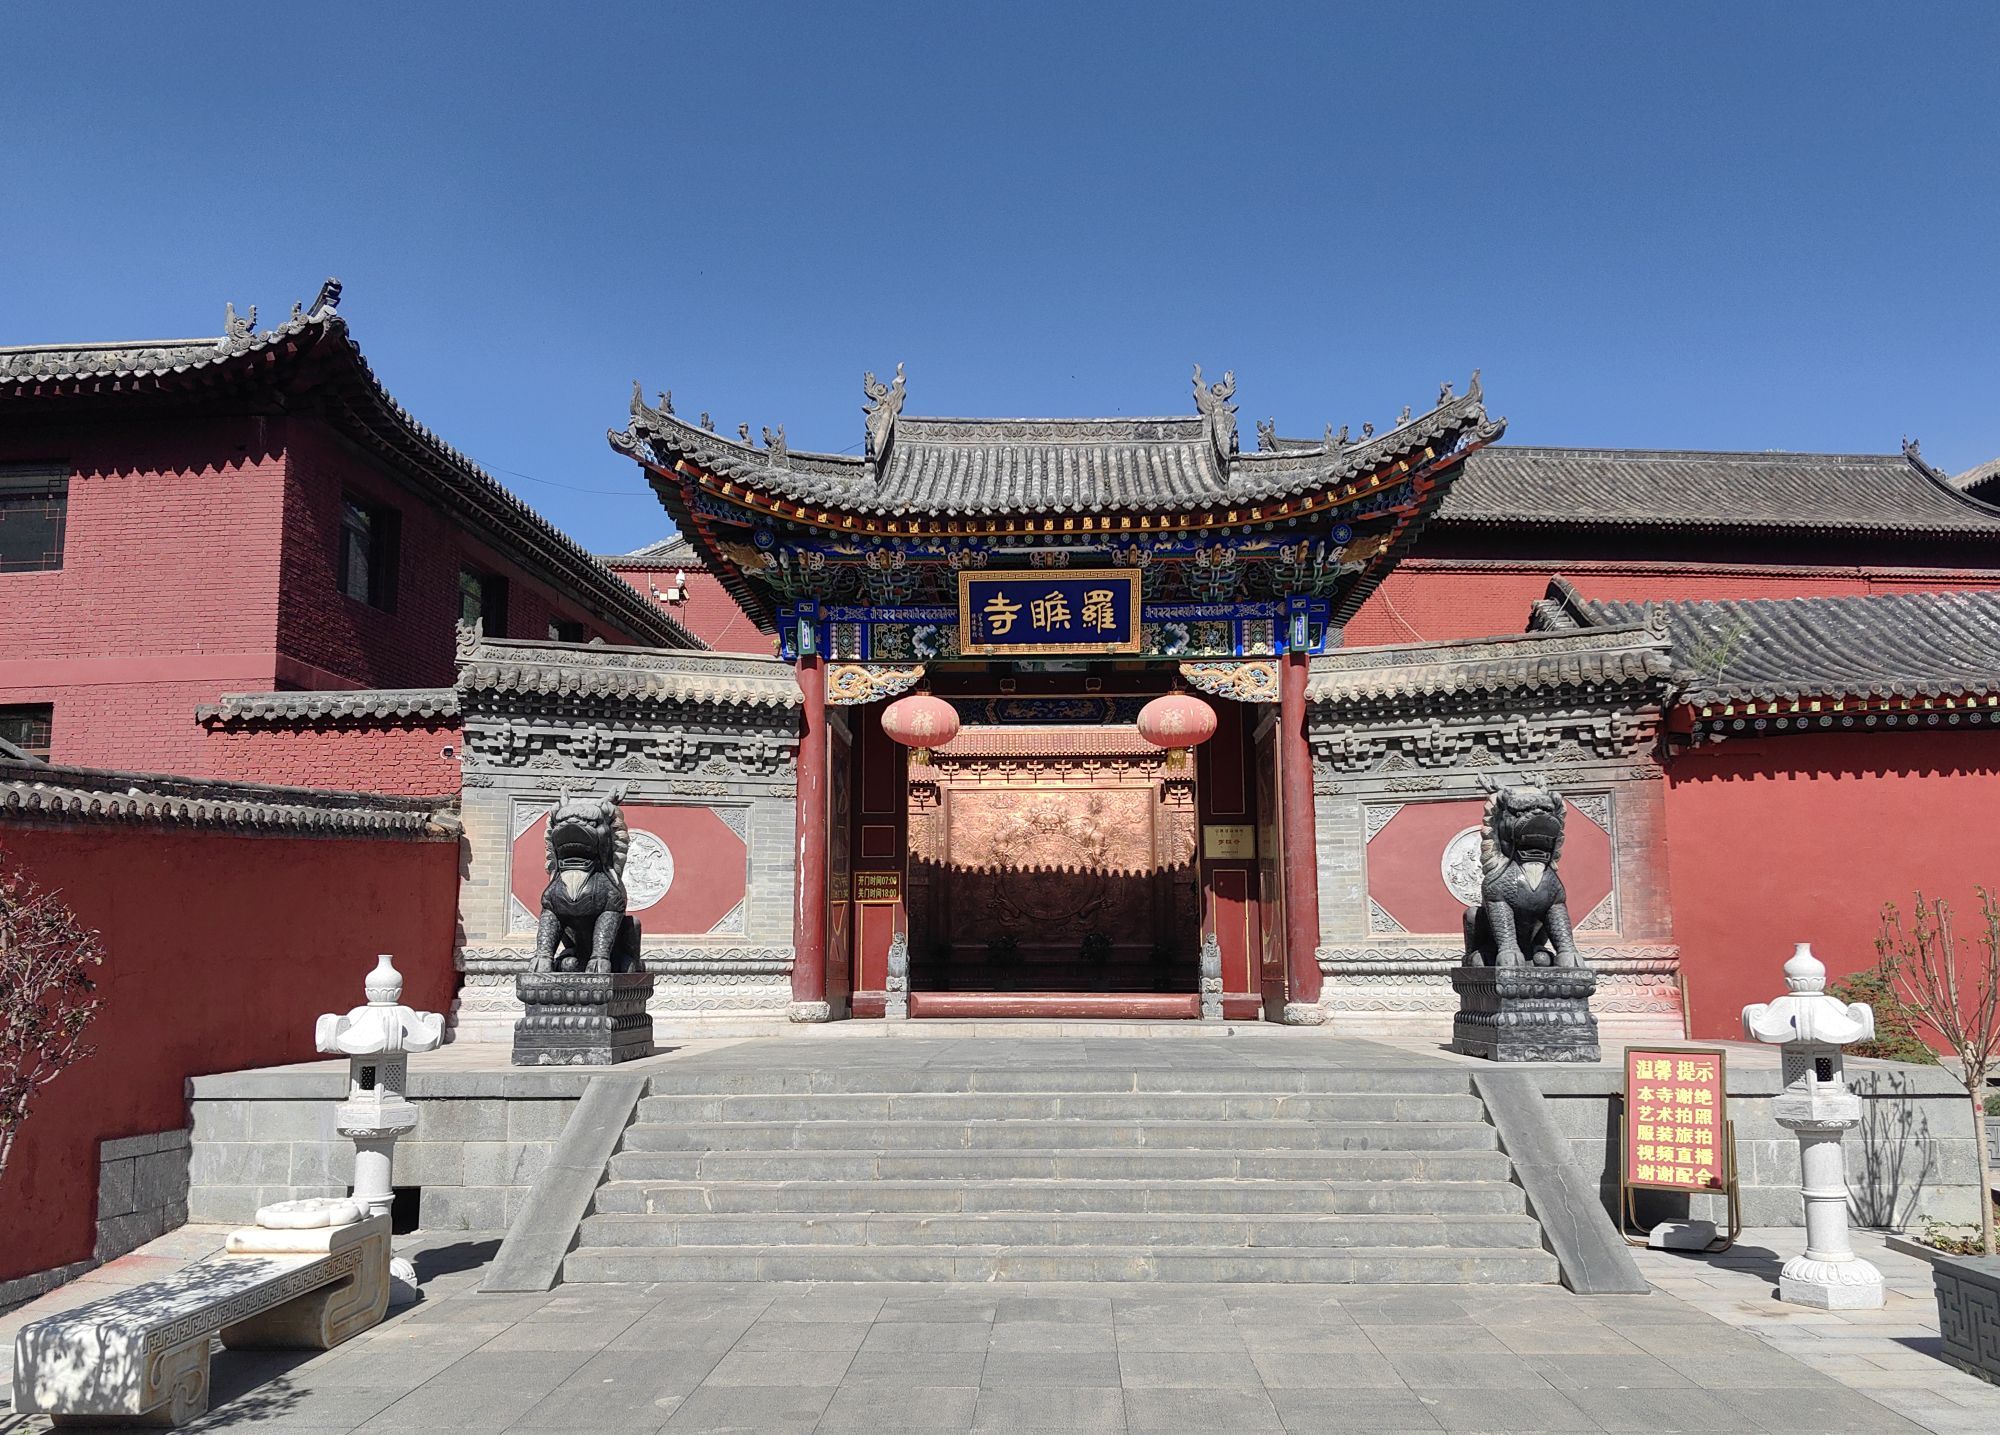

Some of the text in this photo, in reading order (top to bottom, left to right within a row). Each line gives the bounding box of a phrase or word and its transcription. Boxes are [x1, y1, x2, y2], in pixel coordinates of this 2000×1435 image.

[1636, 1059, 1714, 1083] 温馨提示
[1637, 1086, 1713, 1106] 本寺谢绝
[1637, 1106, 1713, 1125] 艺术拍照
[1637, 1125, 1713, 1145] 服装旅拍
[1637, 1144, 1714, 1165] 视频直播
[1637, 1164, 1714, 1186] 谢谢配合
